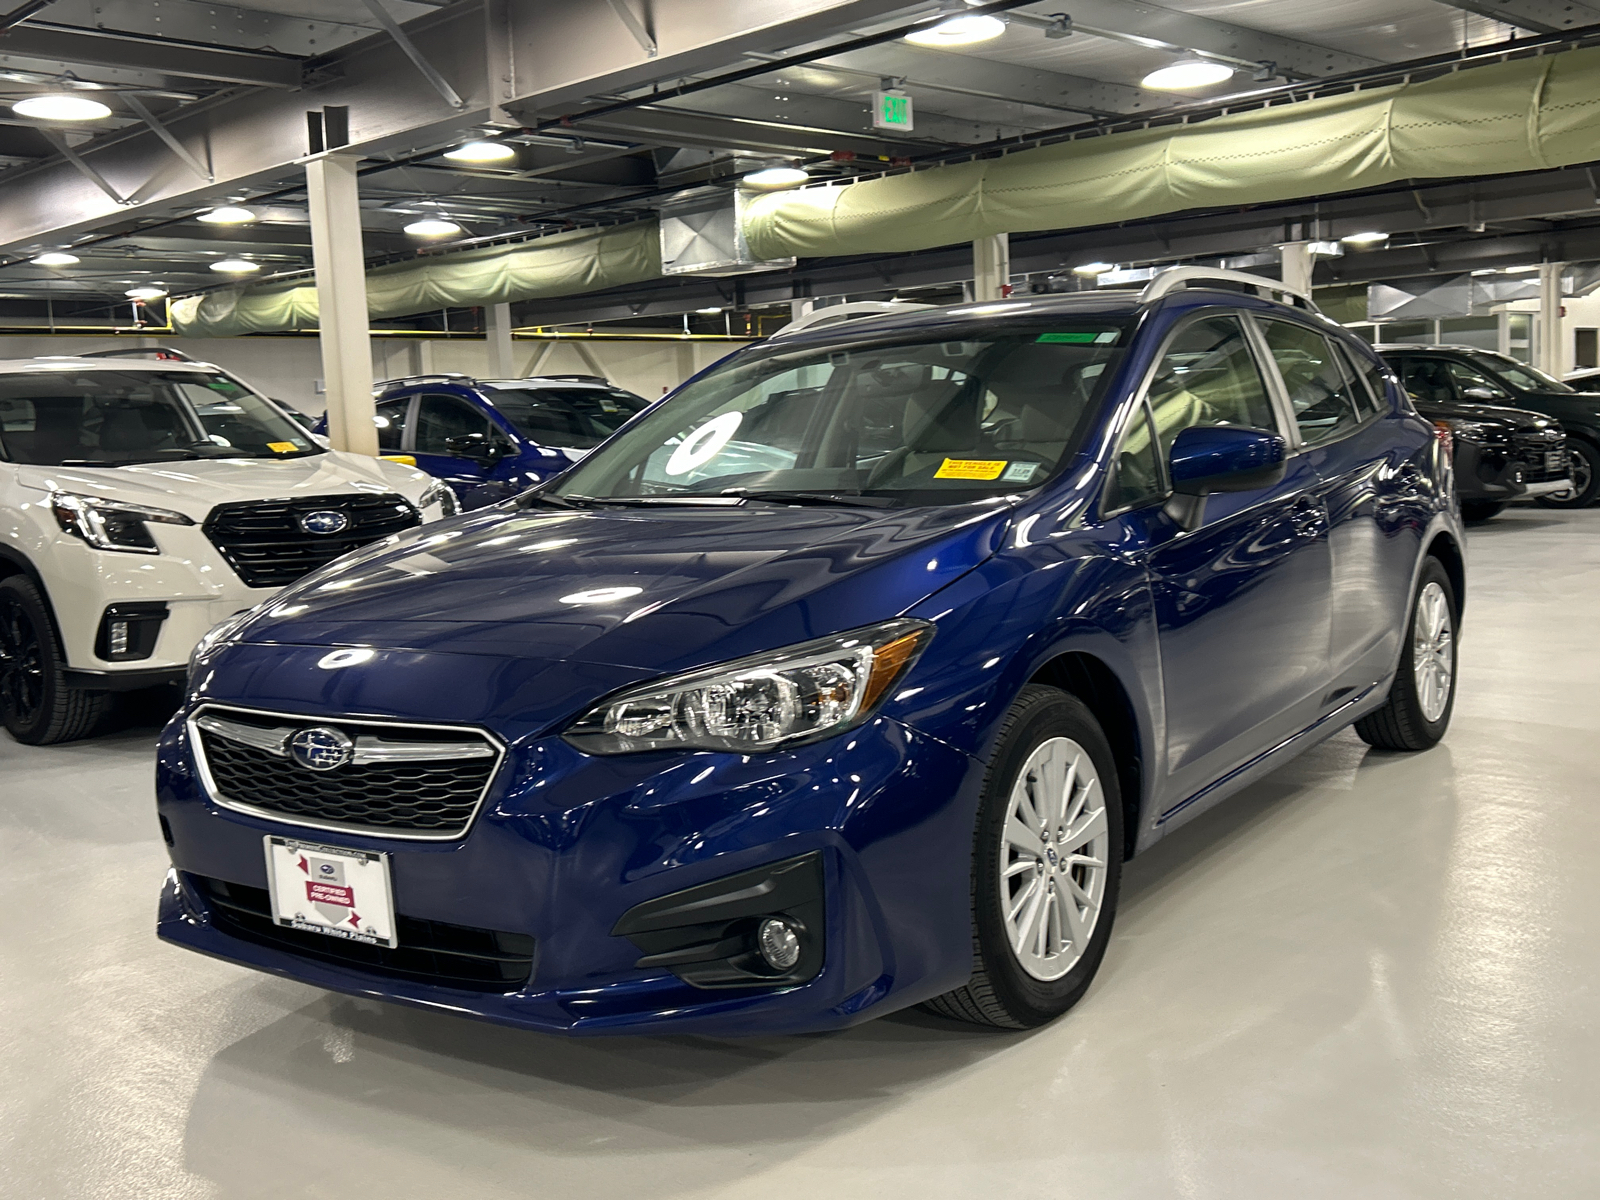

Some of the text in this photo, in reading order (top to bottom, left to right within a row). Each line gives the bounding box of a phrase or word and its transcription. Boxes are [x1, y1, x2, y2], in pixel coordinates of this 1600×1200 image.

[884, 96, 907, 124] EXIT
[310, 891, 351, 904] PRE-OWNED
[312, 884, 347, 897] CERTIFIED
[291, 919, 377, 944] Subaru White Plains
